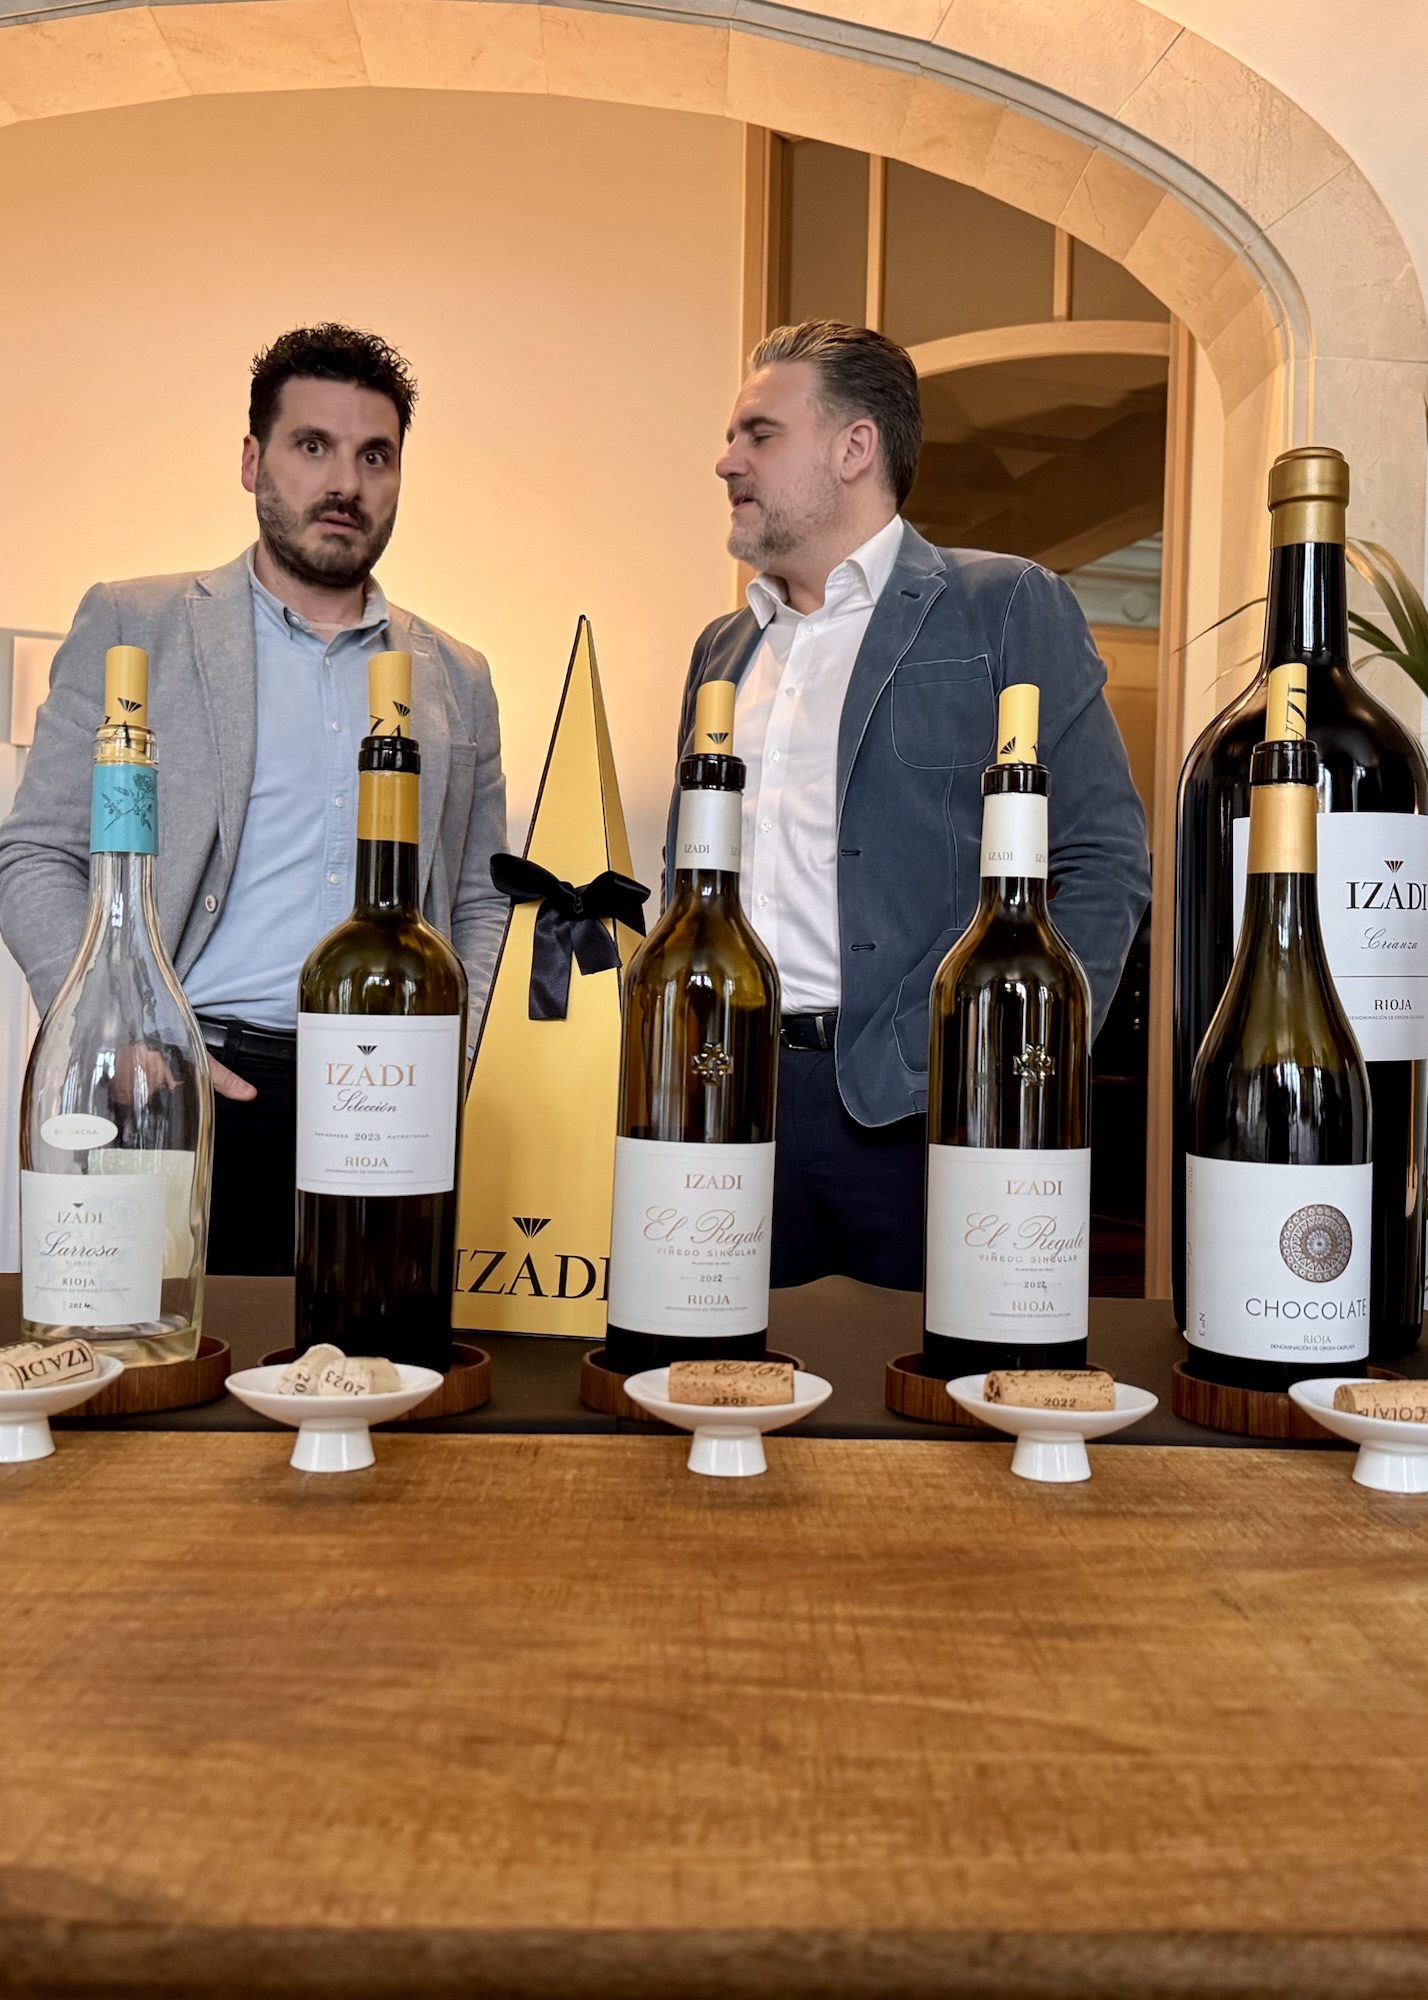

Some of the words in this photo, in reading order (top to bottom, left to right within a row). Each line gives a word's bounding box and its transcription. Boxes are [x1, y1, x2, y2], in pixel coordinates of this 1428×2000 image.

[684, 844, 710, 853] IZADI
[988, 851, 1013, 861] IZADI
[1346, 881, 1427, 911] IZADI
[1360, 927, 1418, 950] Crianza
[1374, 999, 1412, 1011] RIOJA
[325, 1062, 417, 1087] IZADI
[332, 1088, 398, 1113] Selección
[354, 1132, 381, 1142] 2023
[345, 1156, 389, 1168] RIOJA
[684, 1173, 743, 1190] IZADI
[1005, 1180, 1063, 1196] IZADI
[57, 1211, 104, 1224] IZADI
[643, 1205, 689, 1242] El
[964, 1212, 1011, 1249] El
[40, 1230, 121, 1257] Larrosa
[656, 1245, 700, 1257] VIÑEDO
[707, 1247, 757, 1257] SINGULAR
[978, 1252, 1023, 1263] VIÑEDO
[1031, 1254, 1078, 1264] SINGULAR
[453, 1249, 611, 1301] IZADI
[62, 1277, 96, 1288] RIOJA
[687, 1294, 731, 1305] RIOJA
[1012, 1301, 1054, 1312] RIOJA
[1245, 1297, 1367, 1320] CHOCOLATE
[1303, 1334, 1332, 1345] RIOJA
[17, 1347, 90, 1382] IZADI
[1043, 1396, 1077, 1408] 2022
